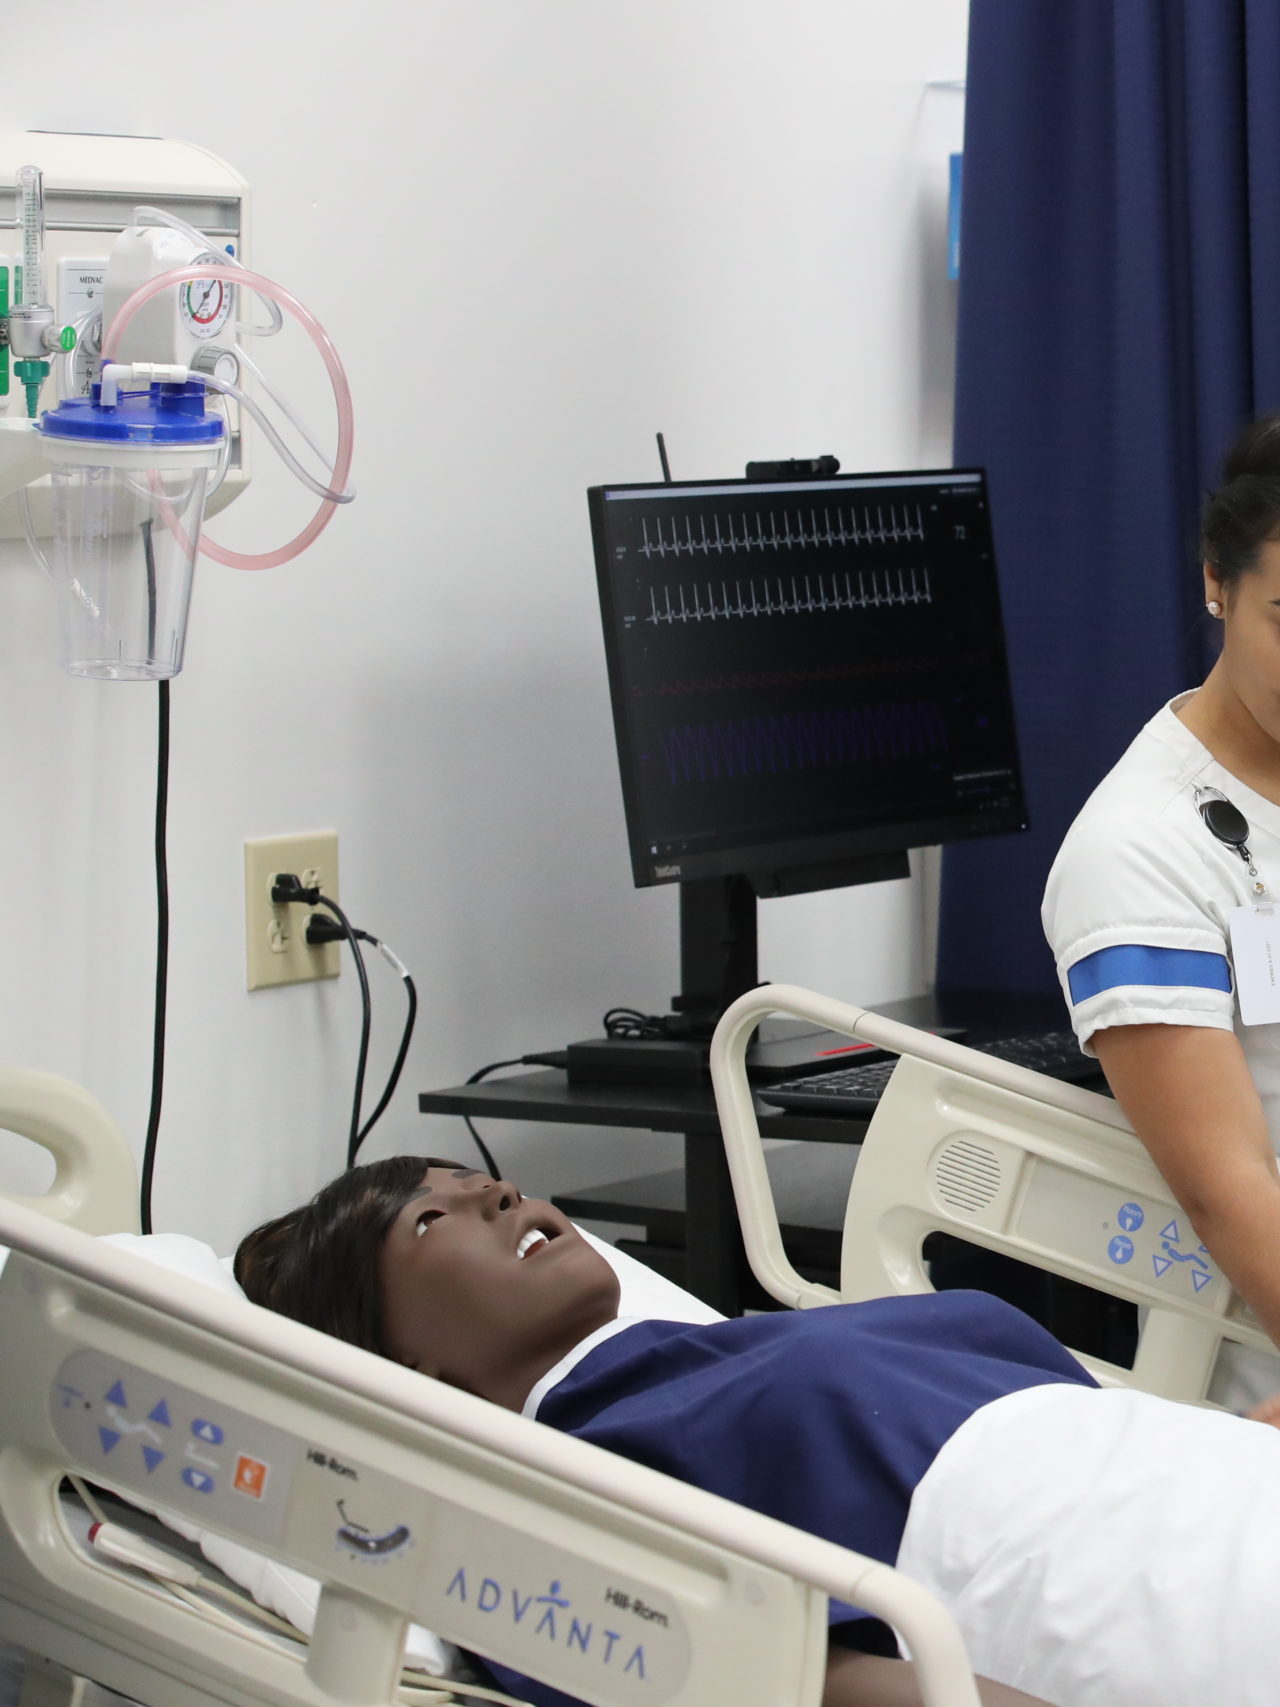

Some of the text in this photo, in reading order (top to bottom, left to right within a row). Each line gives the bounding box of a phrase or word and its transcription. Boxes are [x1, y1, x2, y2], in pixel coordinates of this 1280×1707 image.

[79, 275, 104, 285] MEDVAC
[1122, 1204, 1143, 1218] Room
[306, 1447, 359, 1482] Hill-Rom
[445, 1567, 646, 1680] ADVANTA
[604, 1586, 671, 1629] Hill-Rom
